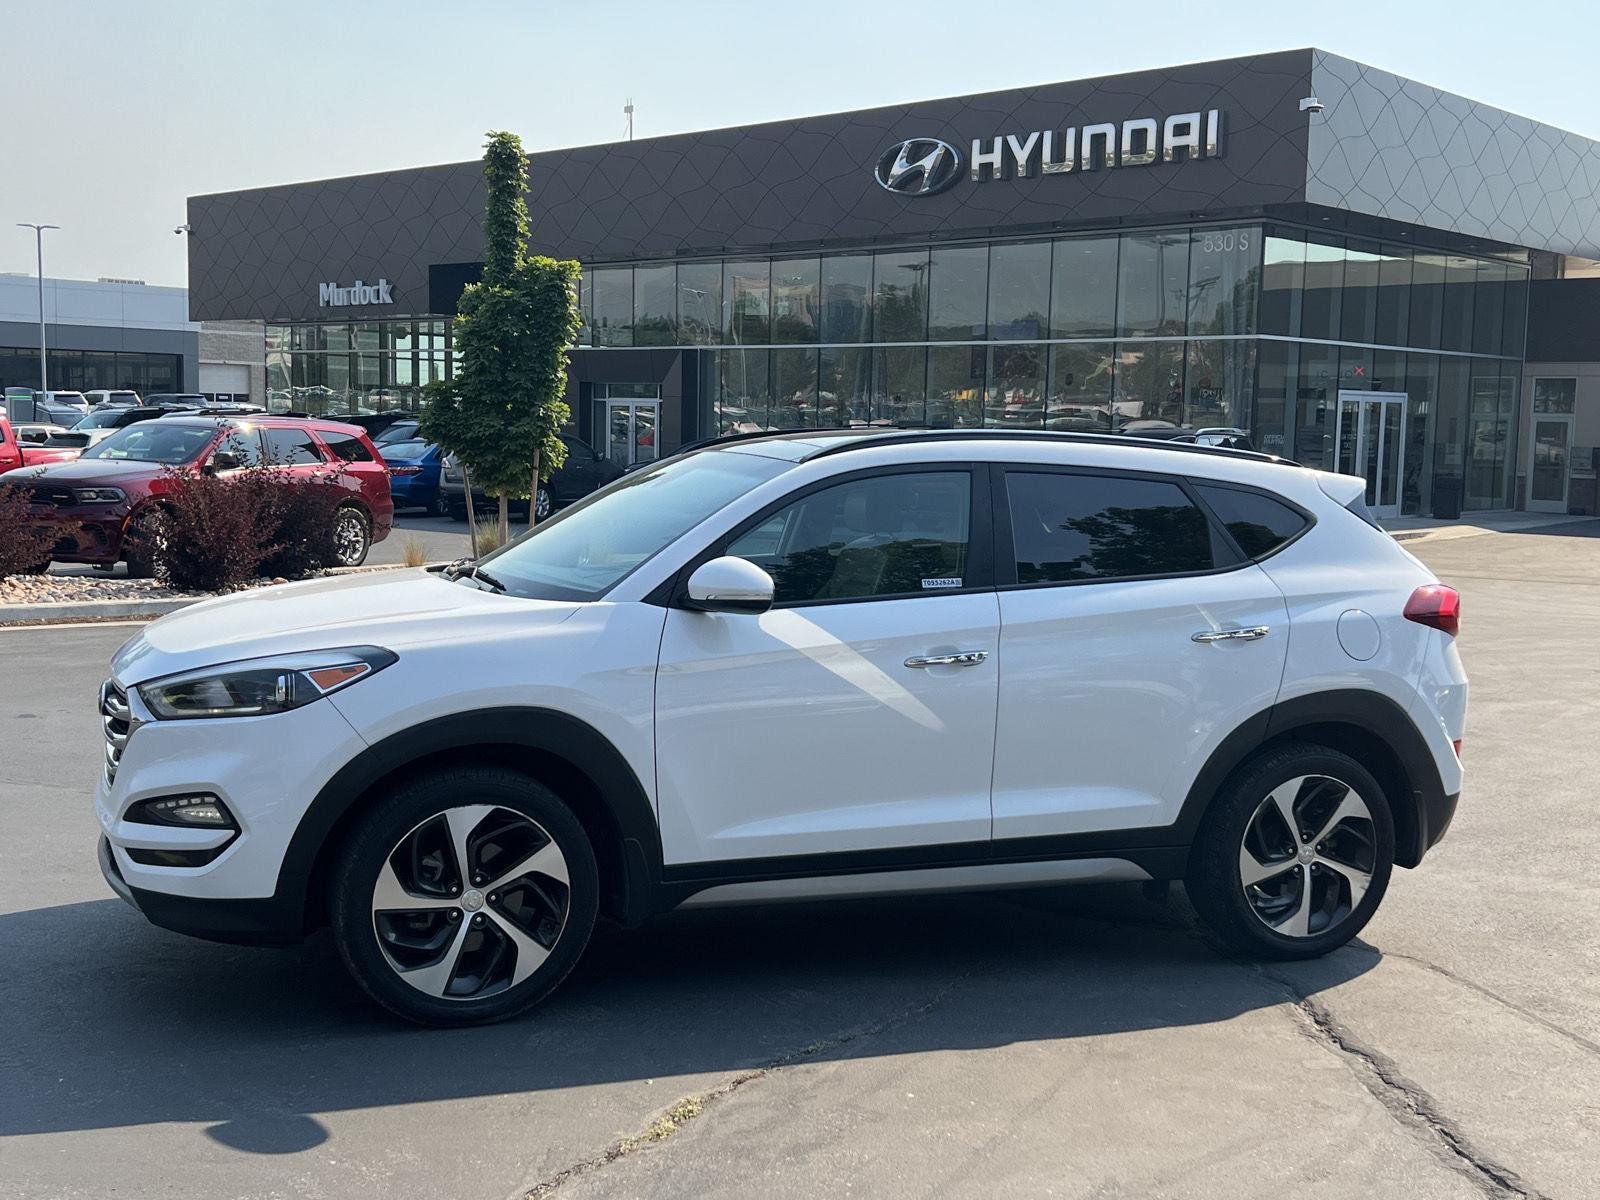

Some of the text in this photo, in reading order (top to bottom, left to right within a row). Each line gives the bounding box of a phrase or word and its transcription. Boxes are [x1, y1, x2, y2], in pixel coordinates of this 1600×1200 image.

[971, 109, 1219, 182] HYUNDAI
[1203, 232, 1249, 252] 530 S
[319, 279, 393, 307] Murdock
